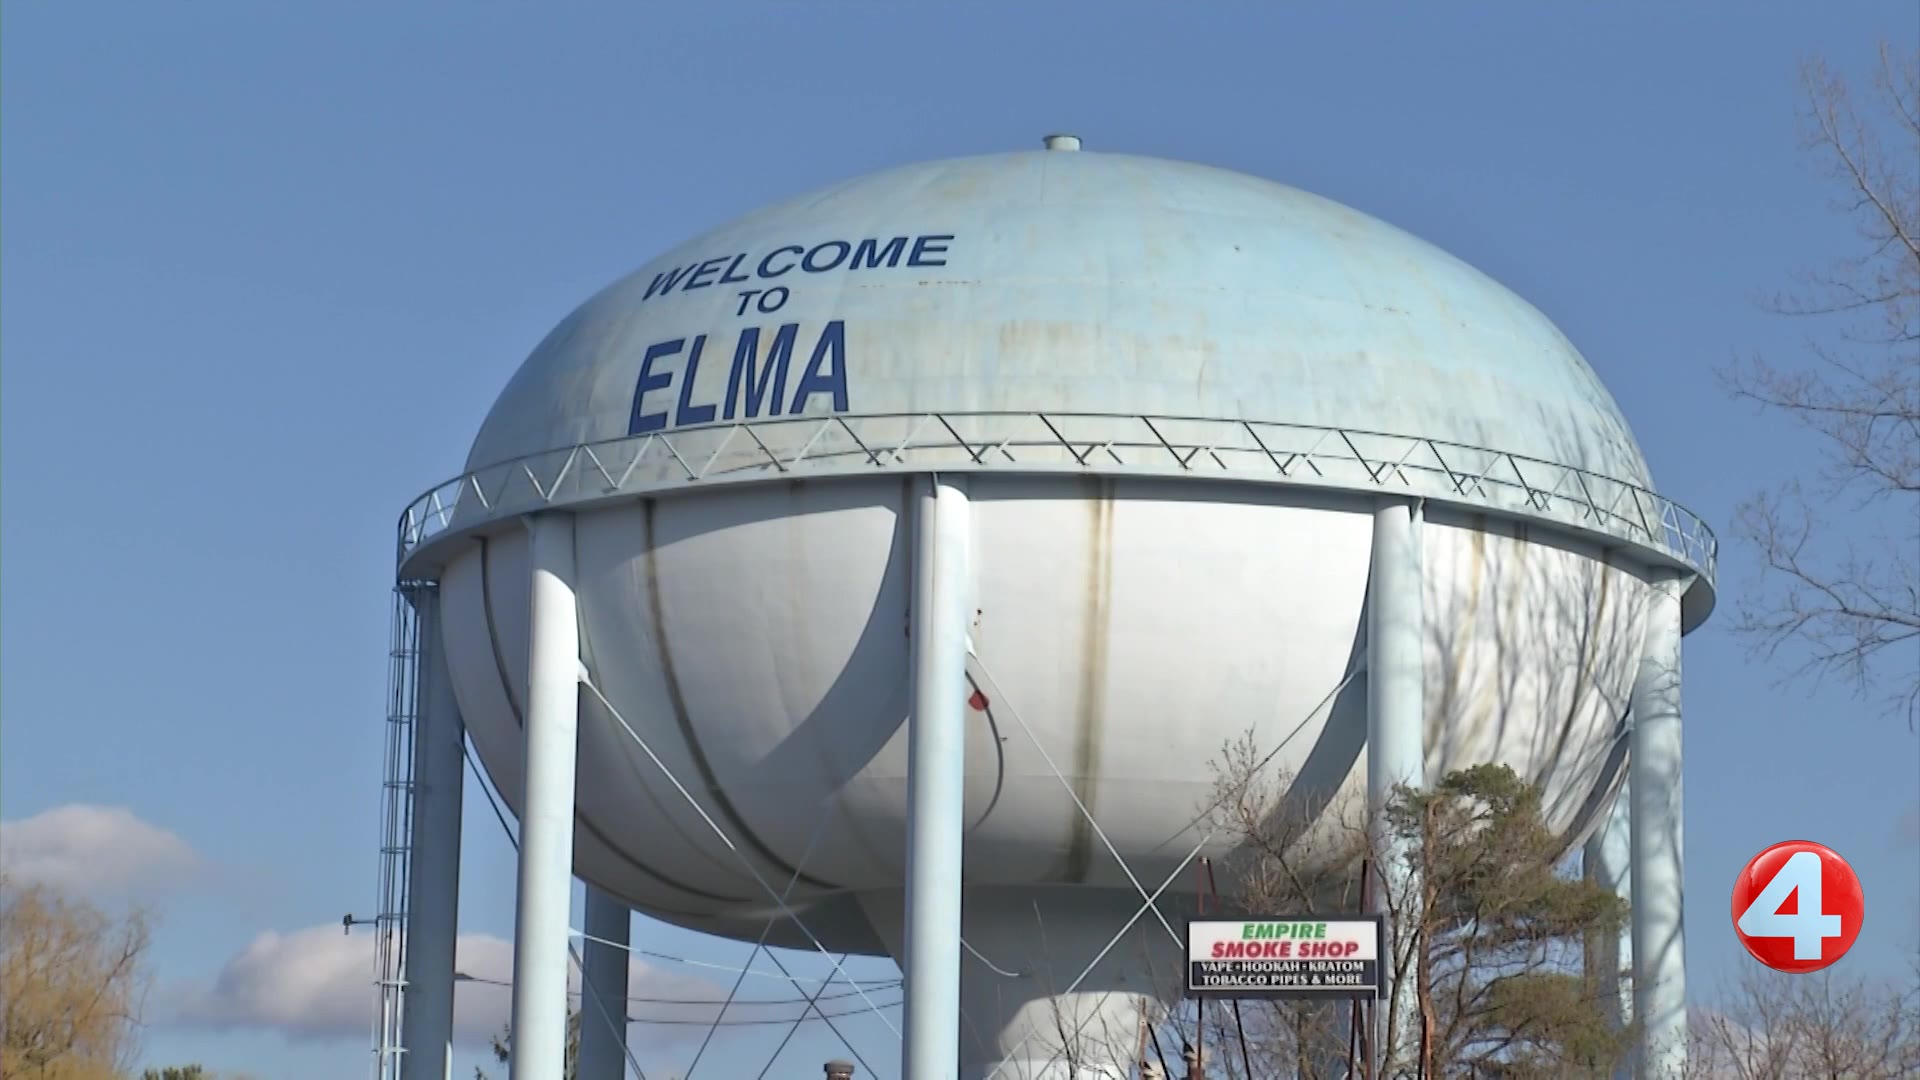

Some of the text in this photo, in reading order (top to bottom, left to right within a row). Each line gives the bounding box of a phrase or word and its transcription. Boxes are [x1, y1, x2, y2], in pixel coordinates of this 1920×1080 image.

[642, 235, 955, 301] WELCOME
[736, 286, 790, 316] TO
[628, 320, 849, 436] ELMA
[1242, 923, 1327, 940] EMPIRE
[1212, 941, 1359, 958] SMOKE SHOP
[1201, 961, 1364, 972] VAPE HOOKAH KRATOM
[1203, 974, 1363, 985] TOBACCO PIPES & MORE
